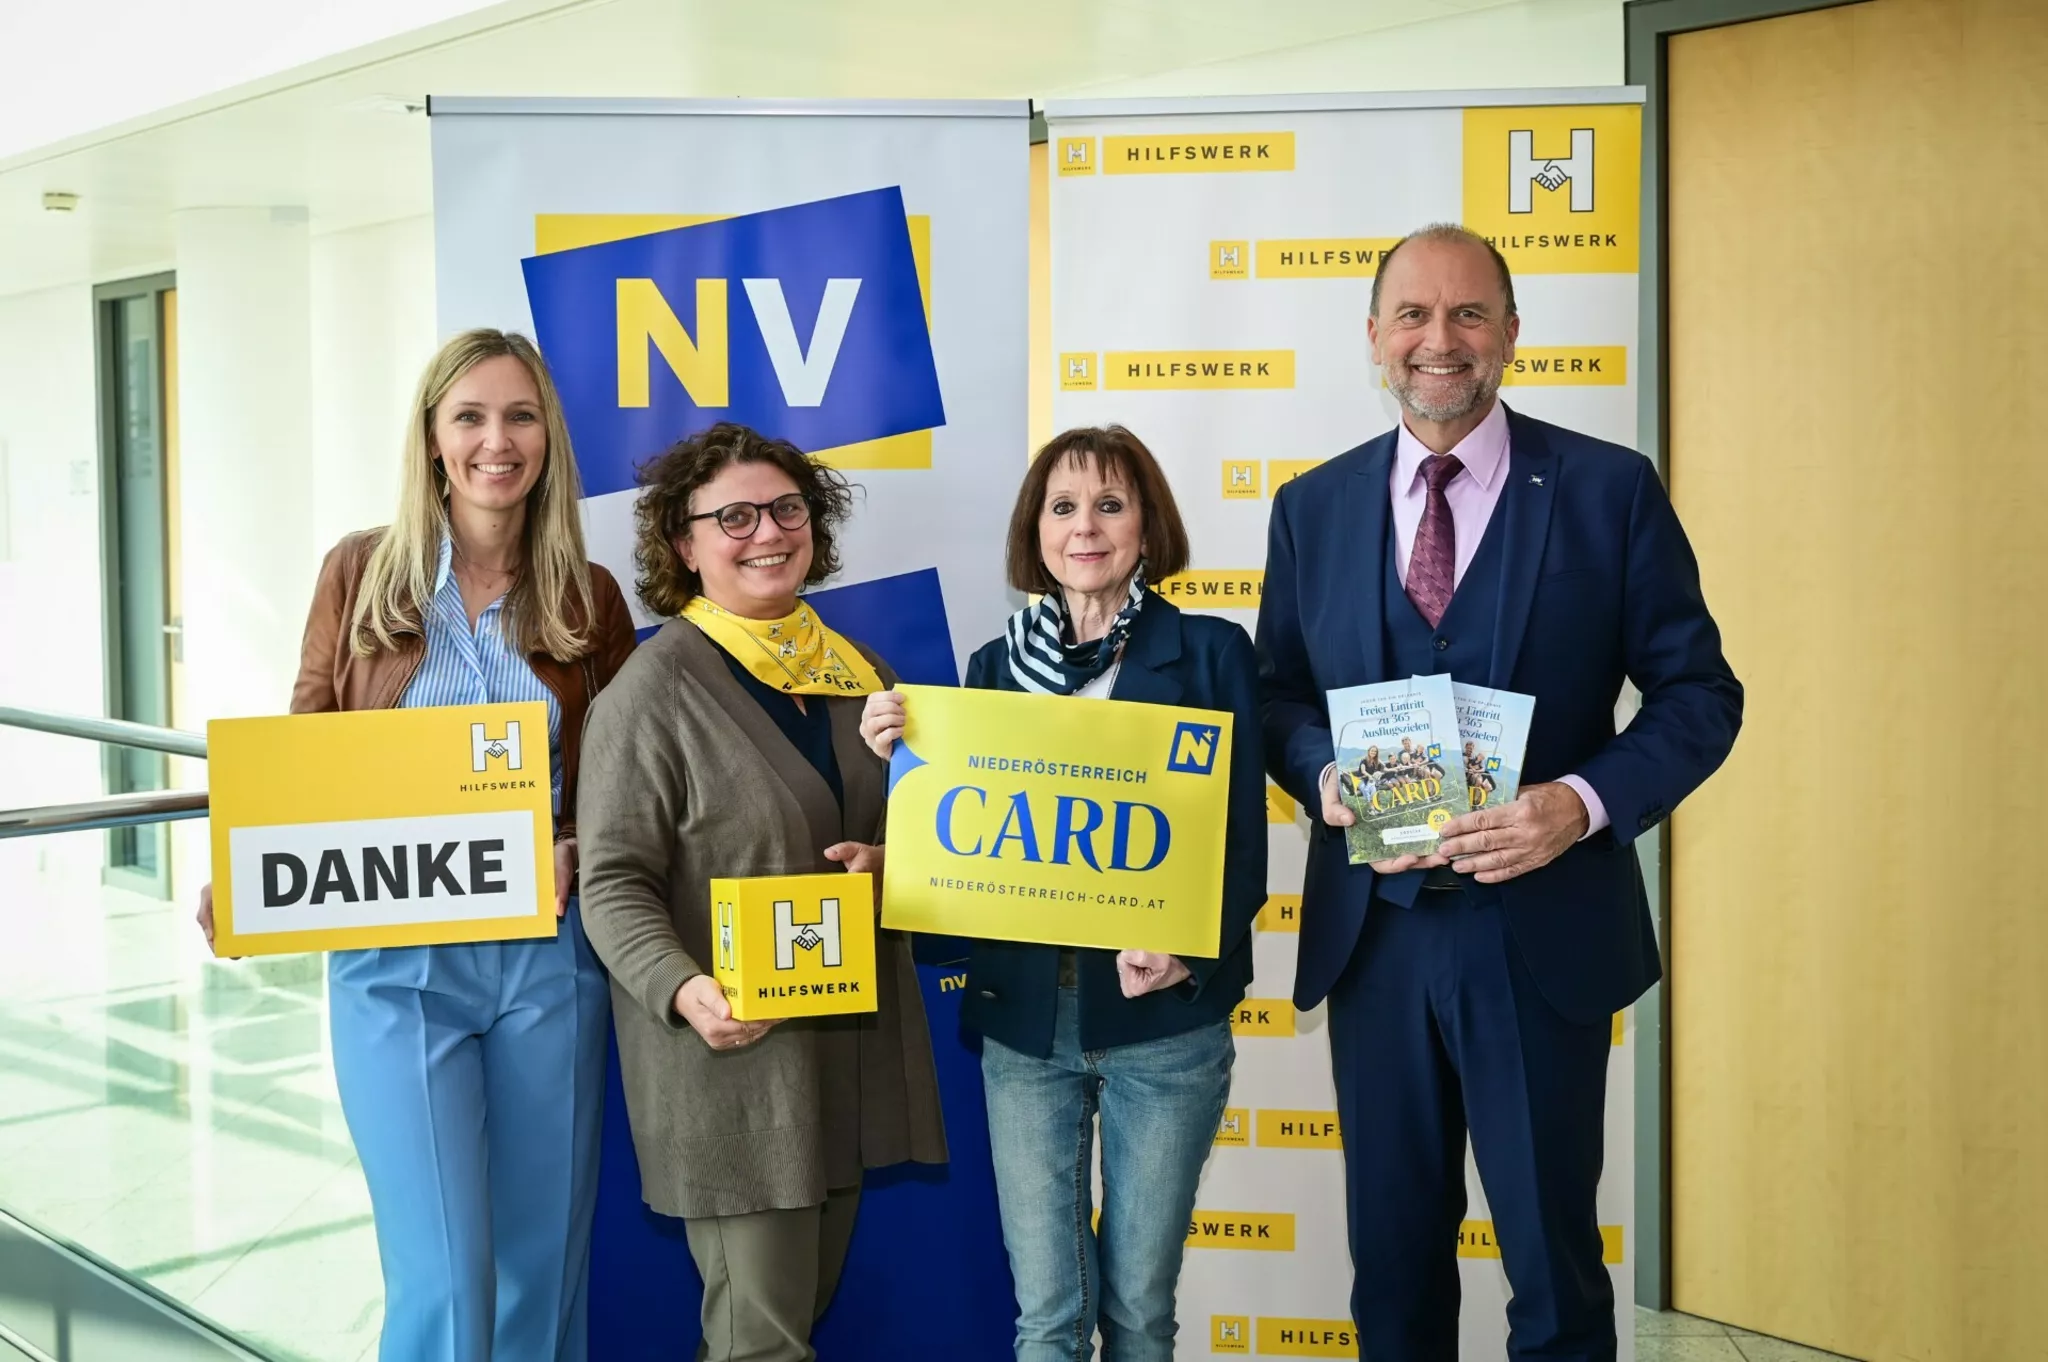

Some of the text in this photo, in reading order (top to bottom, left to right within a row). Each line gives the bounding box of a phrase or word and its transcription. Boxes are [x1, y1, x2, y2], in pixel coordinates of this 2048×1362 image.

[1127, 144, 1270, 161] HILFSWERK
[1484, 234, 1617, 249] HILFSWERK
[616, 278, 863, 408] NV
[1128, 362, 1270, 377] HILFSWERK
[1503, 358, 1602, 373] SWERK
[1360, 699, 1425, 717] Freier Eintritt
[1466, 705, 1501, 720] Eintritt
[1391, 711, 1411, 723] 365
[1465, 716, 1483, 728] 365
[1361, 722, 1430, 739] Ausflugszielen
[968, 755, 1148, 784] NIEDERÖSTERREICH
[460, 780, 536, 792] HILFSWERK
[1372, 777, 1441, 812] CARD
[935, 785, 1171, 874] CARD
[261, 838, 508, 908] DANKE
[929, 876, 1167, 911] NIEDERÖSTERREICH-CARD.AT
[758, 981, 860, 999] HILFSWERK
[1281, 1122, 1342, 1137] HILF
[1281, 1330, 1360, 1345] HILFS
